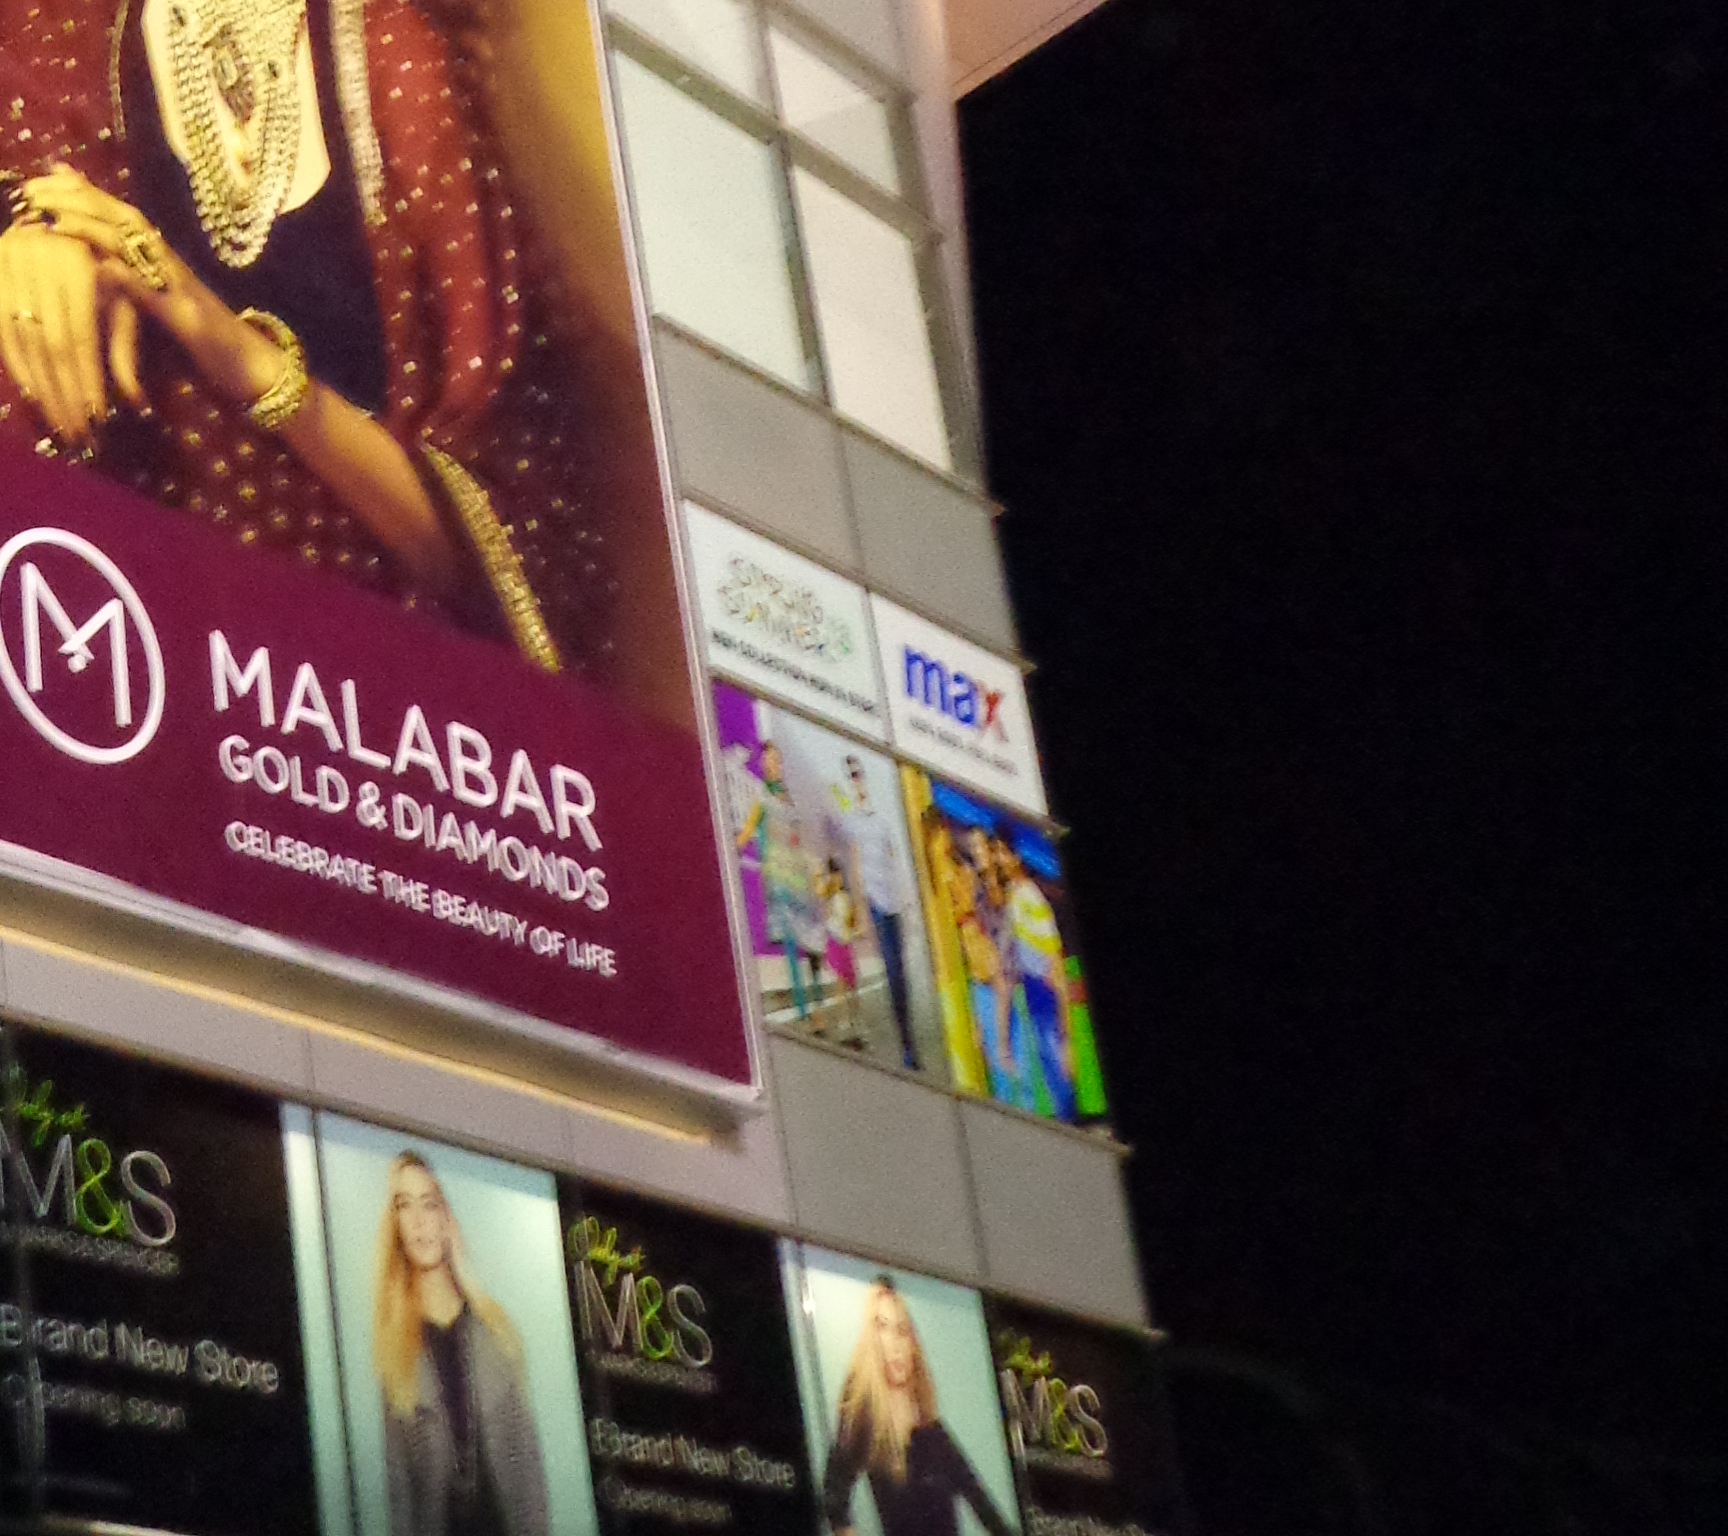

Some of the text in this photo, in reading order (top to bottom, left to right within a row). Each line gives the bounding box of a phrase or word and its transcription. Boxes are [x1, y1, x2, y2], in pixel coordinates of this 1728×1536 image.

[209, 629, 604, 853] MALABAR
[903, 643, 1009, 743] max
[218, 734, 351, 815] GOLD
[391, 791, 612, 912] DIAMONDS
[224, 820, 619, 978] CELEBRATE THE BEAUTY OF LIFE
[113, 1320, 190, 1376] New
[194, 1338, 280, 1395] Store
[573, 1260, 714, 1369] M&S
